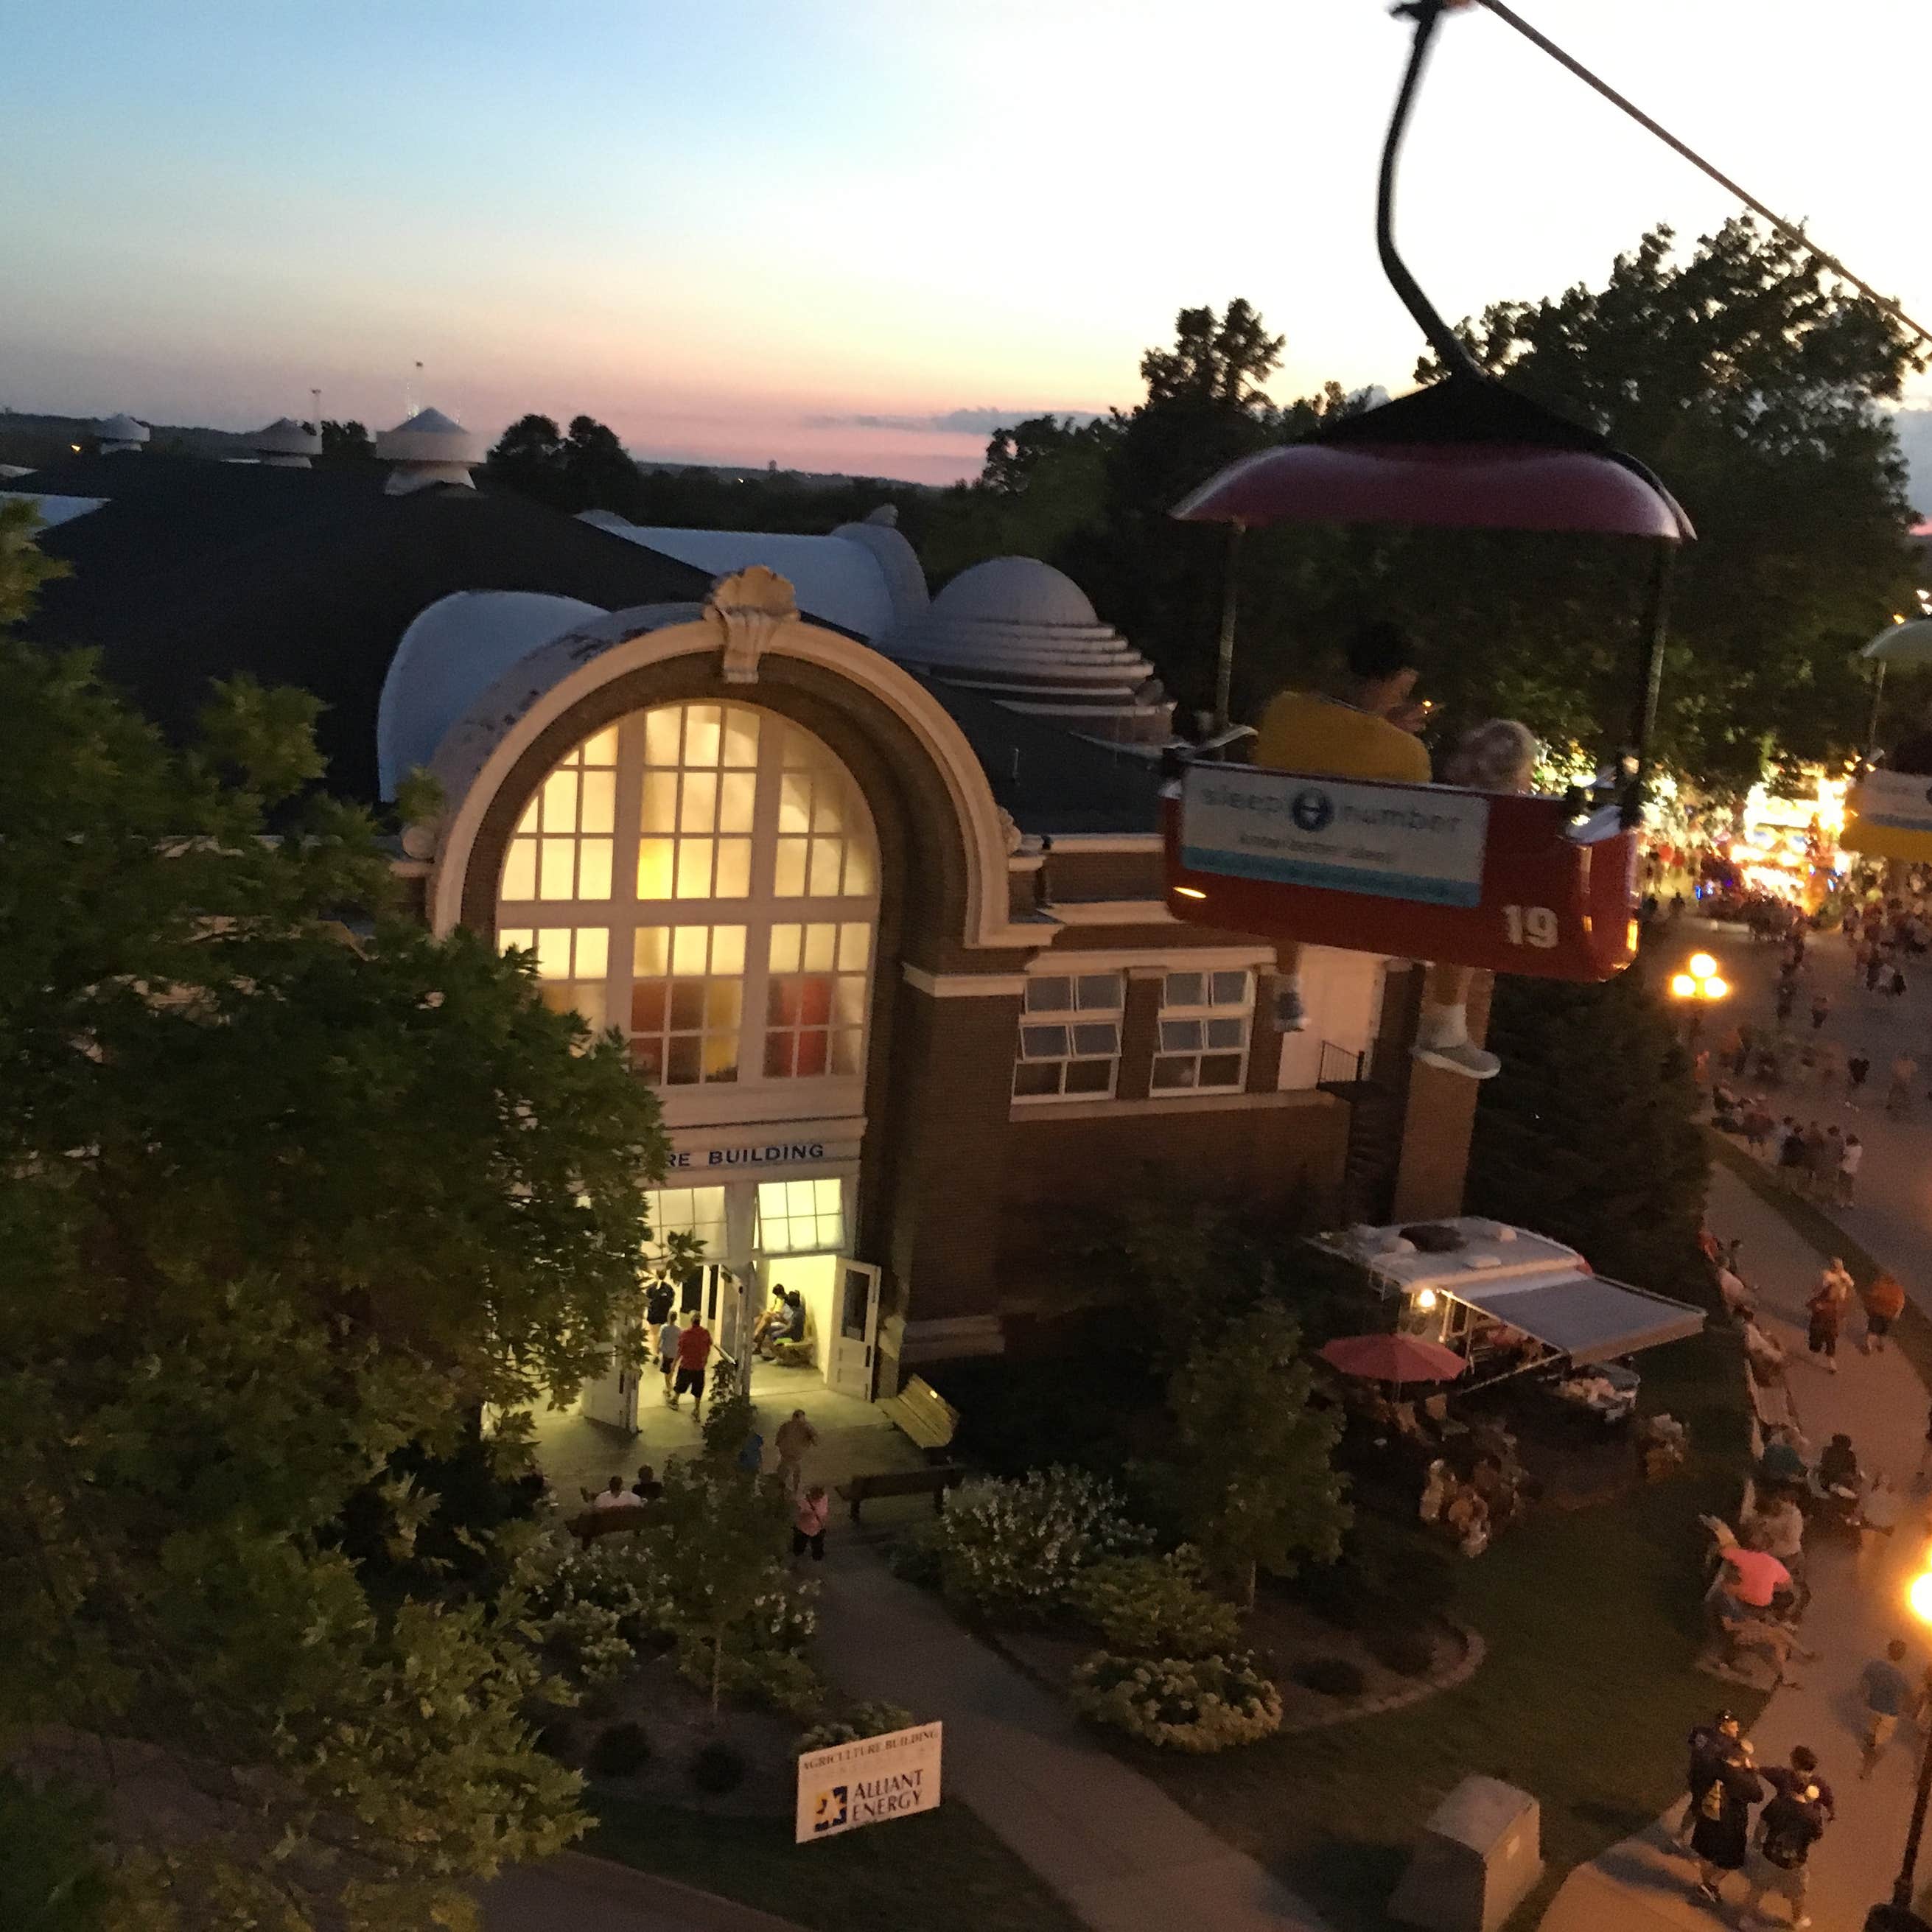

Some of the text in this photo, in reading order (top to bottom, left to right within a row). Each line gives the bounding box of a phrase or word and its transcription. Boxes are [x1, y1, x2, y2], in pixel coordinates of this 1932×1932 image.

[1500, 904, 1559, 948] 19
[708, 1144, 824, 1166] BUILDING
[803, 1731, 939, 1770] AGRICULTURE BUILDING
[853, 1768, 923, 1801] ALLIANT
[853, 1790, 923, 1822] ENERGY
